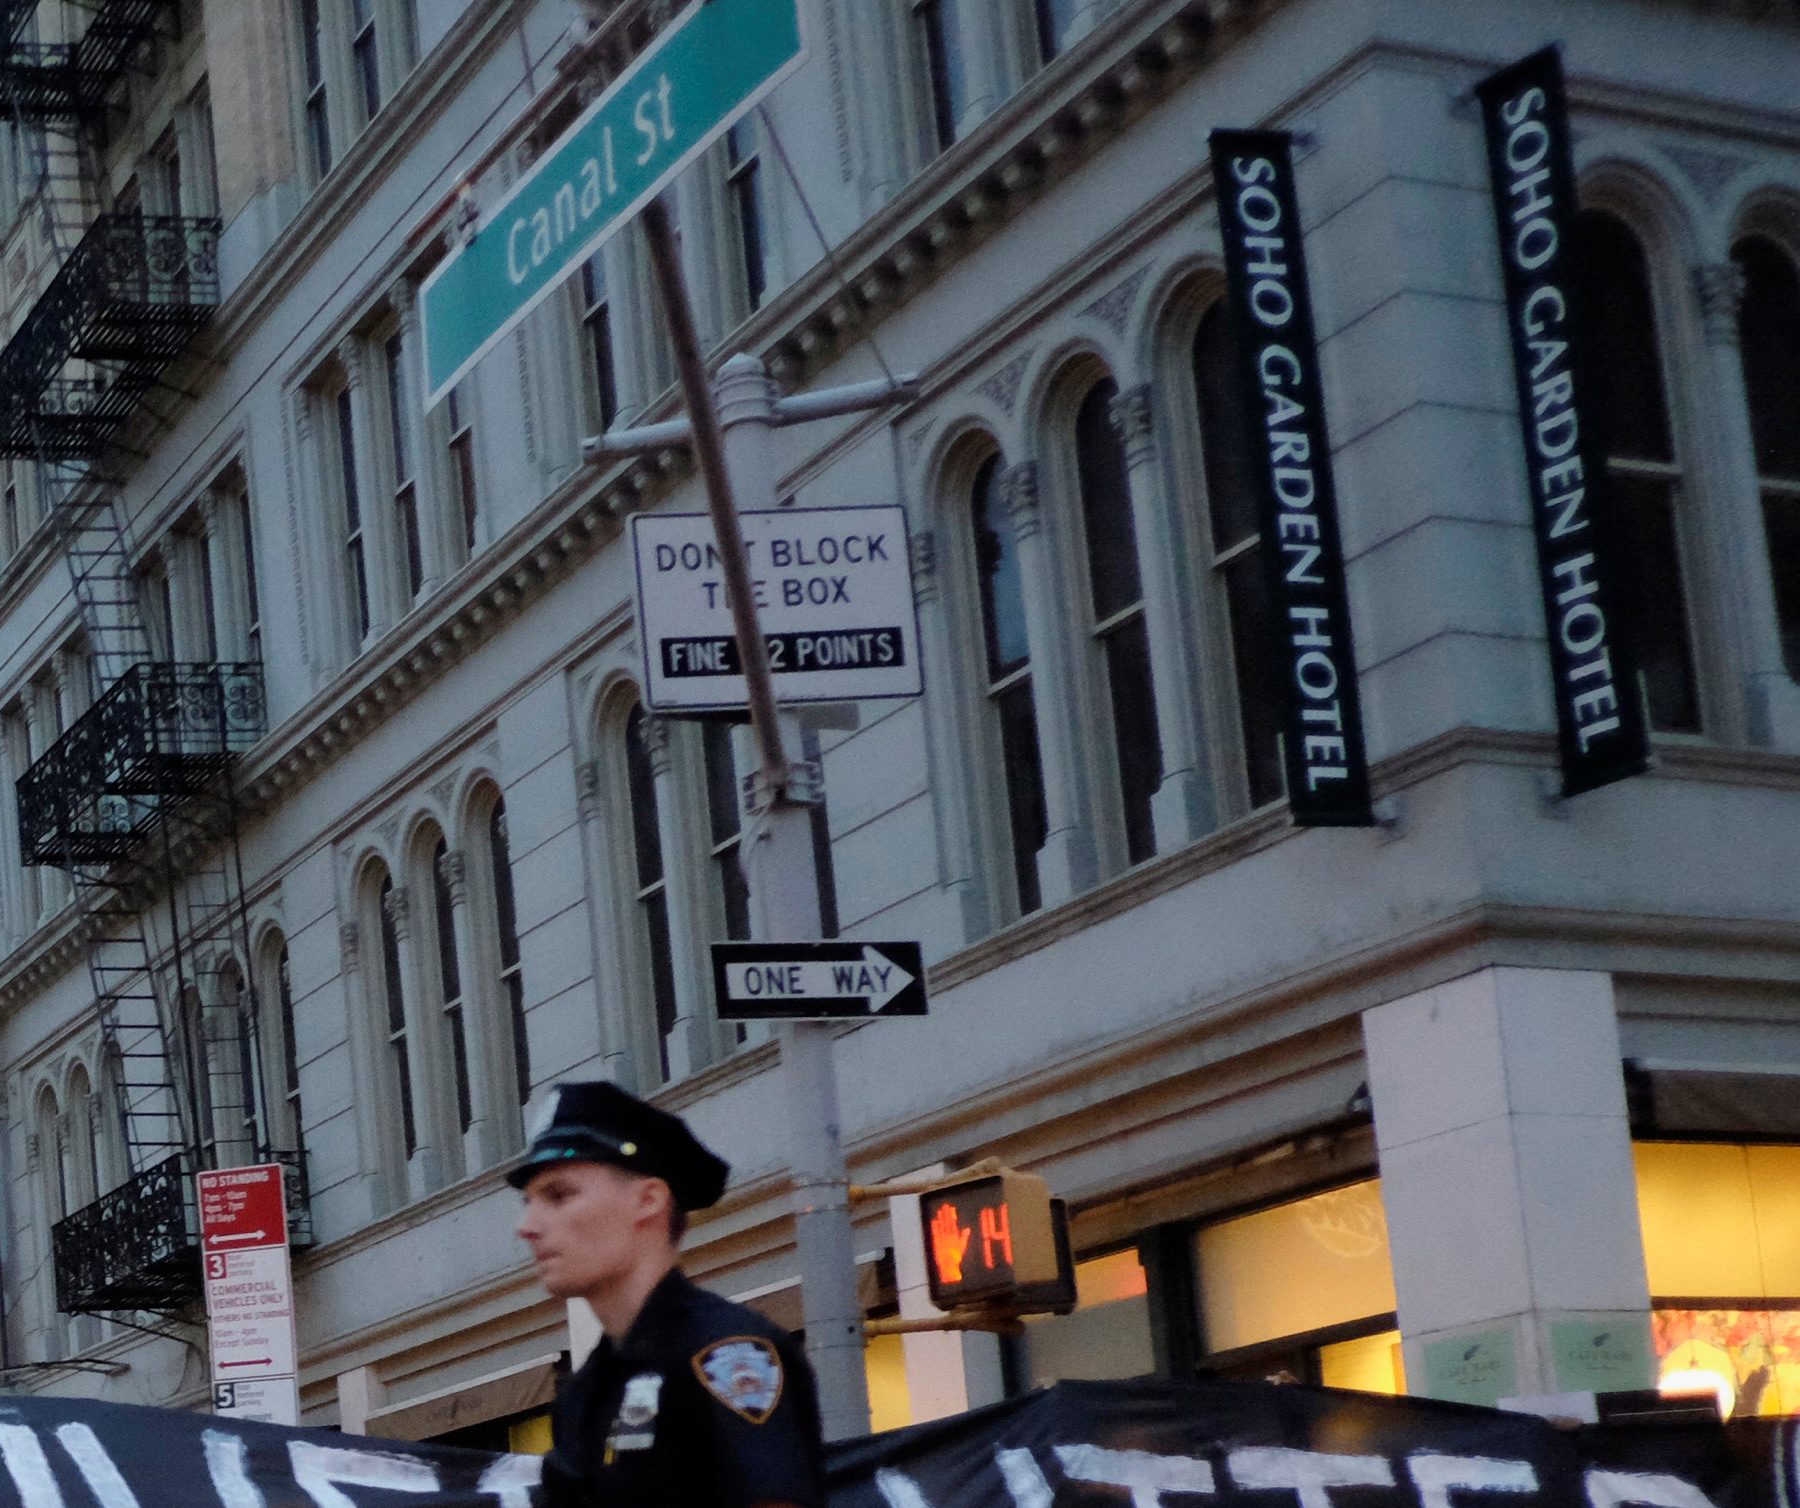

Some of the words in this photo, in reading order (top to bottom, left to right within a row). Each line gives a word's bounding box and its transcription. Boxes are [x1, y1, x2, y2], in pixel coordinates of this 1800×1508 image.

[507, 126, 618, 285] Canal
[633, 73, 676, 167] St
[1502, 86, 1559, 271] SOHO
[1232, 156, 1294, 326] SOHO
[1258, 343, 1327, 585] GARDEN
[1523, 285, 1592, 540] GARDEN
[656, 541, 756, 573] DON
[771, 534, 889, 569] BLOCK
[702, 579, 770, 610] TE
[782, 575, 851, 608] BOX
[669, 641, 731, 673] FINE
[797, 633, 895, 667] POINTS
[1289, 605, 1349, 792] HOTEL
[1553, 552, 1622, 756] HOTEL
[744, 966, 805, 996] ONE
[831, 965, 893, 994] WAY
[202, 1176, 217, 1189] NO
[219, 1171, 269, 1187] STANDING
[209, 1255, 224, 1278] 3
[218, 1384, 233, 1407] 5
